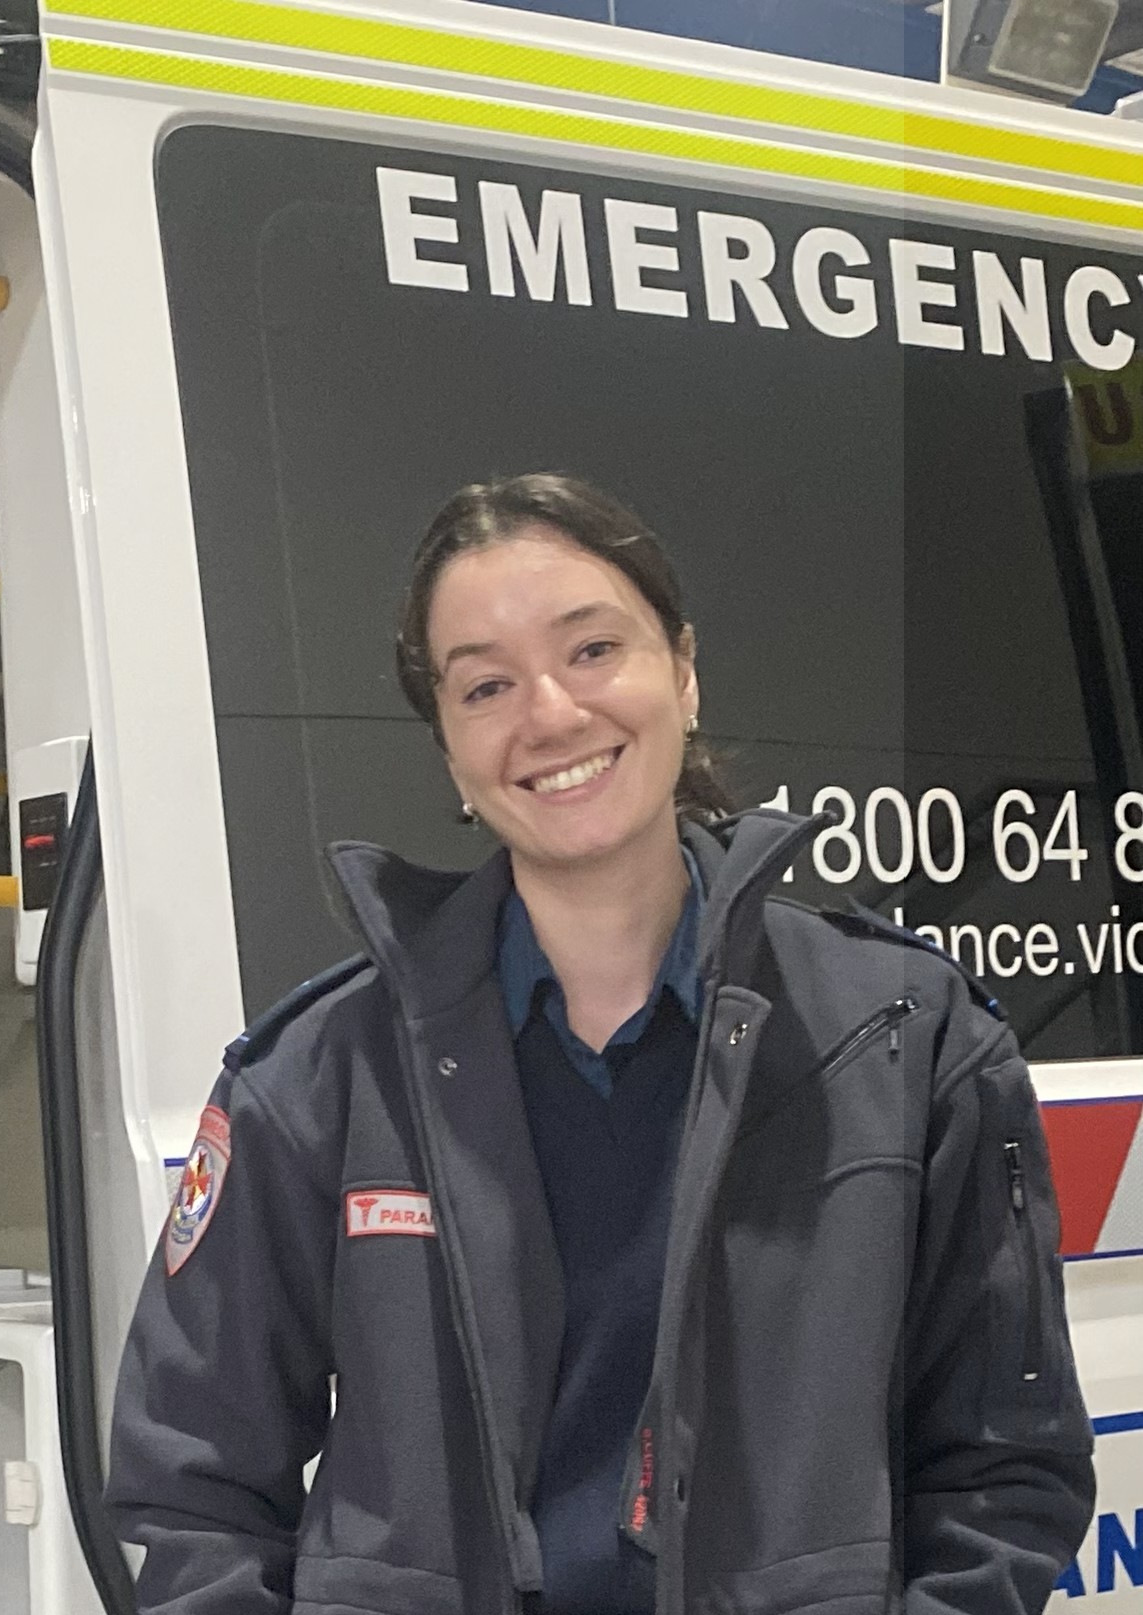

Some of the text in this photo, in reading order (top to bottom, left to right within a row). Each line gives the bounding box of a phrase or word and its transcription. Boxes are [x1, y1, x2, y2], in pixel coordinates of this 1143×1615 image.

[375, 165, 1143, 371] EMERGENC
[992, 788, 1089, 883] 64
[893, 904, 1143, 978] nce.vic
[379, 1208, 434, 1226] PARA
